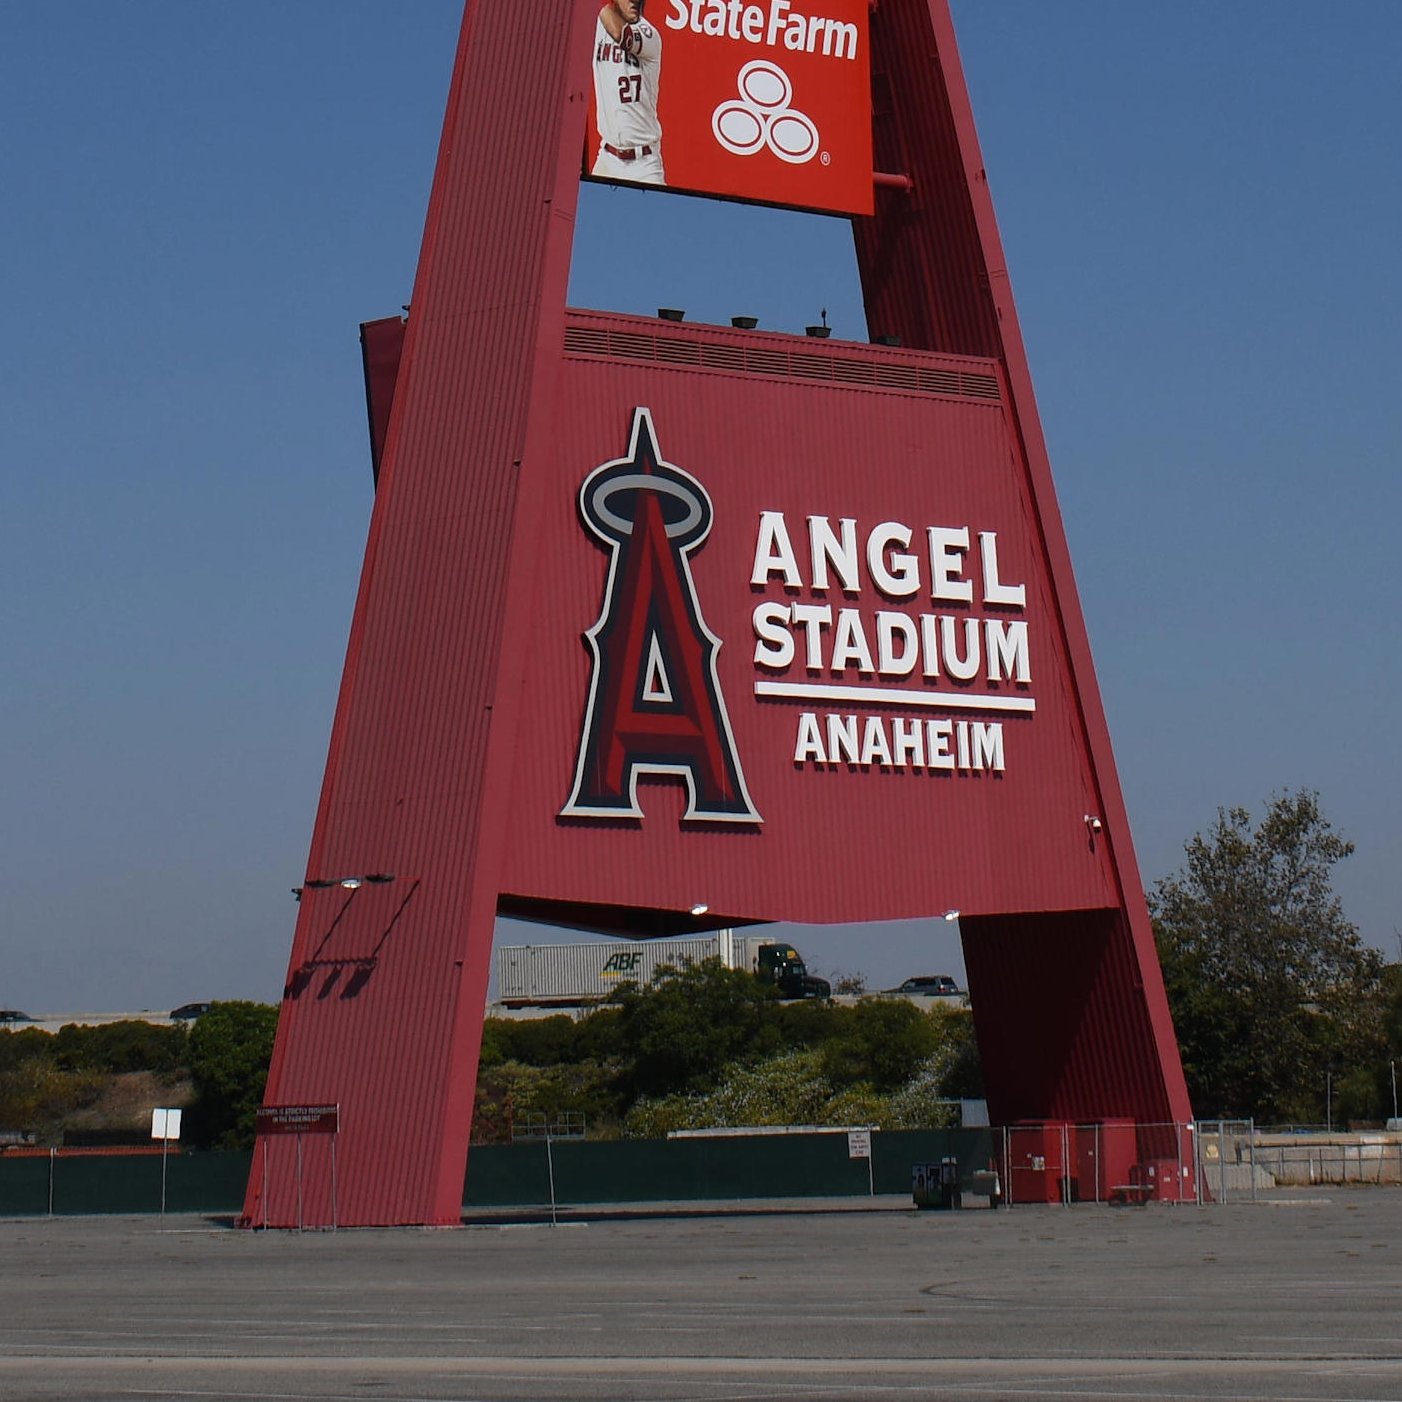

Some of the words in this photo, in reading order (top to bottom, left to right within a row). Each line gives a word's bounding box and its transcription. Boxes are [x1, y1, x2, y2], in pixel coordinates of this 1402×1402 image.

[618, 74, 642, 104] 27
[750, 510, 1026, 608] ANGEL
[752, 601, 1032, 683] STADIUM
[794, 712, 1006, 771] ANAHEIM
[603, 952, 643, 971] ABF
